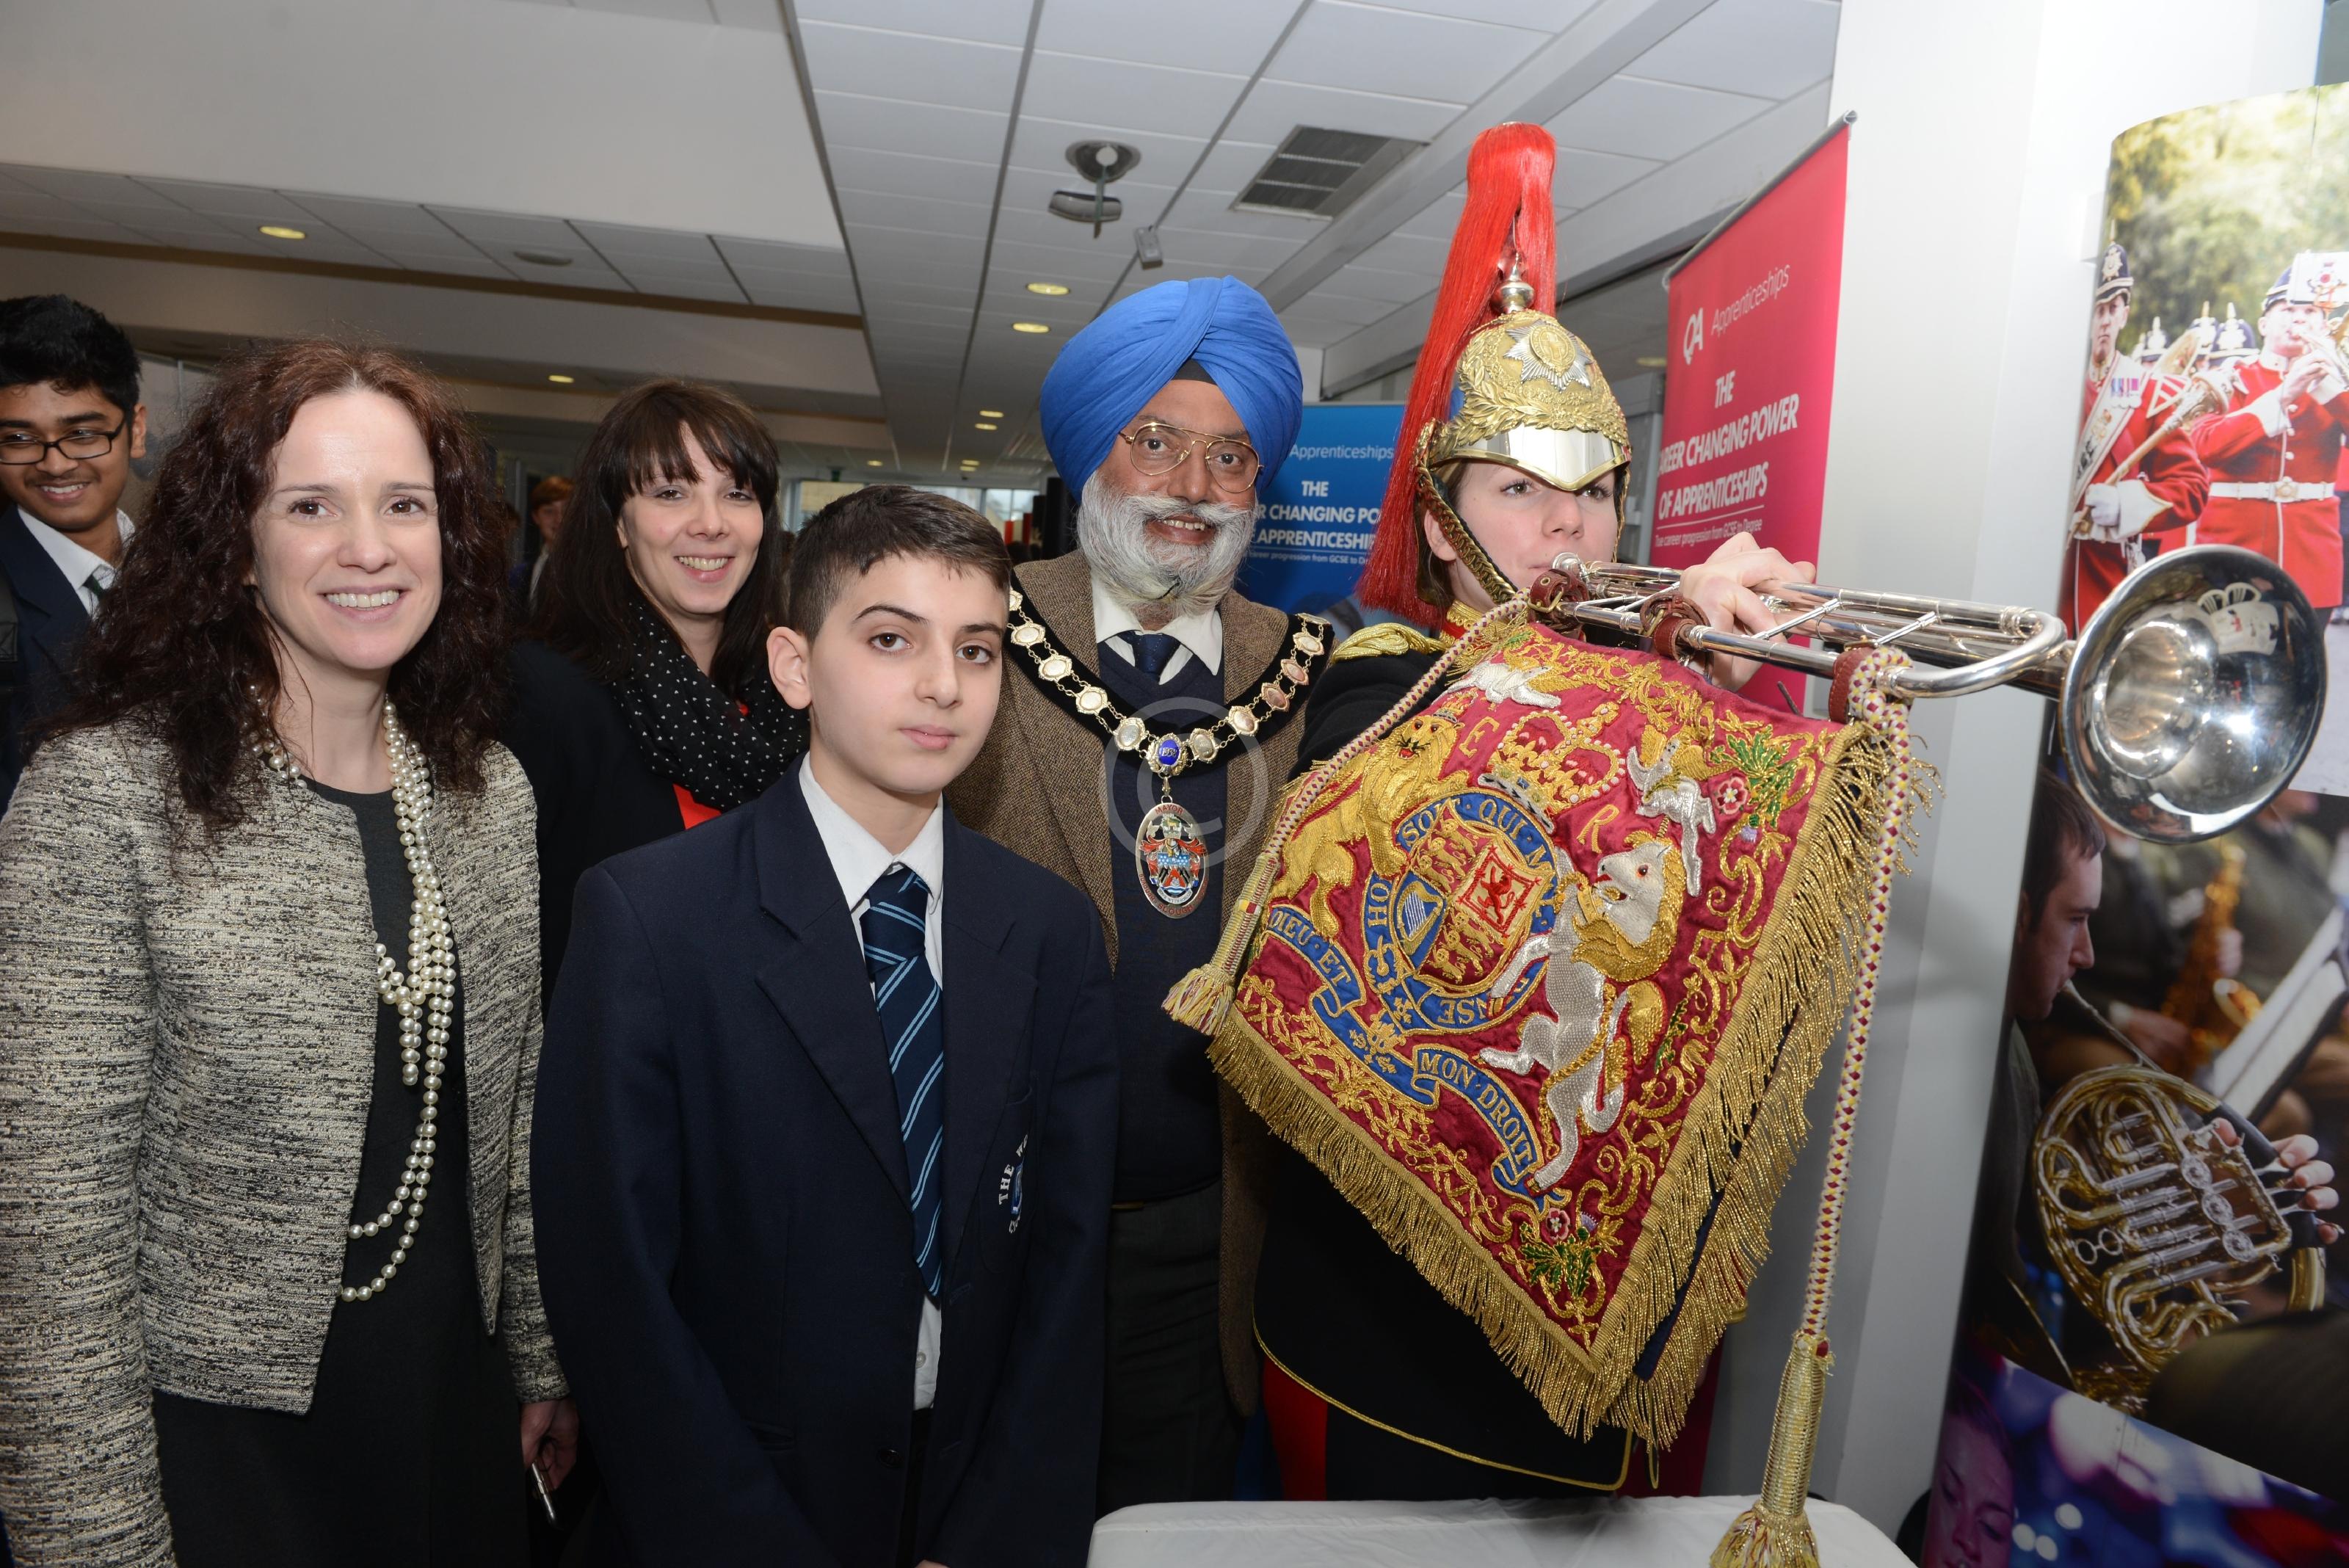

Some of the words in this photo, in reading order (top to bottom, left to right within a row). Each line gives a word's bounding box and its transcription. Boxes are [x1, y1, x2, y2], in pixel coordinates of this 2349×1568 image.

[1711, 264, 1790, 338] Apprenticeships
[1715, 370, 1736, 409] THE
[1658, 440, 1685, 476] AREER
[1686, 415, 1750, 467] CHANGING
[1749, 393, 1800, 445] POWER
[1290, 444, 1394, 461] Apprenticeships
[1301, 480, 1329, 497] THE
[1658, 490, 1674, 520] OF
[1671, 461, 1769, 518] APPRENTICESHIPS
[1269, 504, 1355, 523] CHANGING
[1257, 529, 1376, 550] APPRENTICESHIP
[1681, 527, 1712, 548] progression
[1271, 552, 1310, 562] progression
[1312, 553, 1328, 562] from
[1329, 556, 1348, 564] GCSE
[1350, 556, 1357, 565] to
[1155, 805, 1183, 815] MAYOR
[1479, 799, 1528, 840] QUI
[1271, 910, 1313, 945] DIEU
[1318, 954, 1351, 988] ET
[1419, 1052, 1476, 1090] MON
[1477, 1085, 1535, 1166] DROIT
[998, 1164, 1014, 1205] THE
